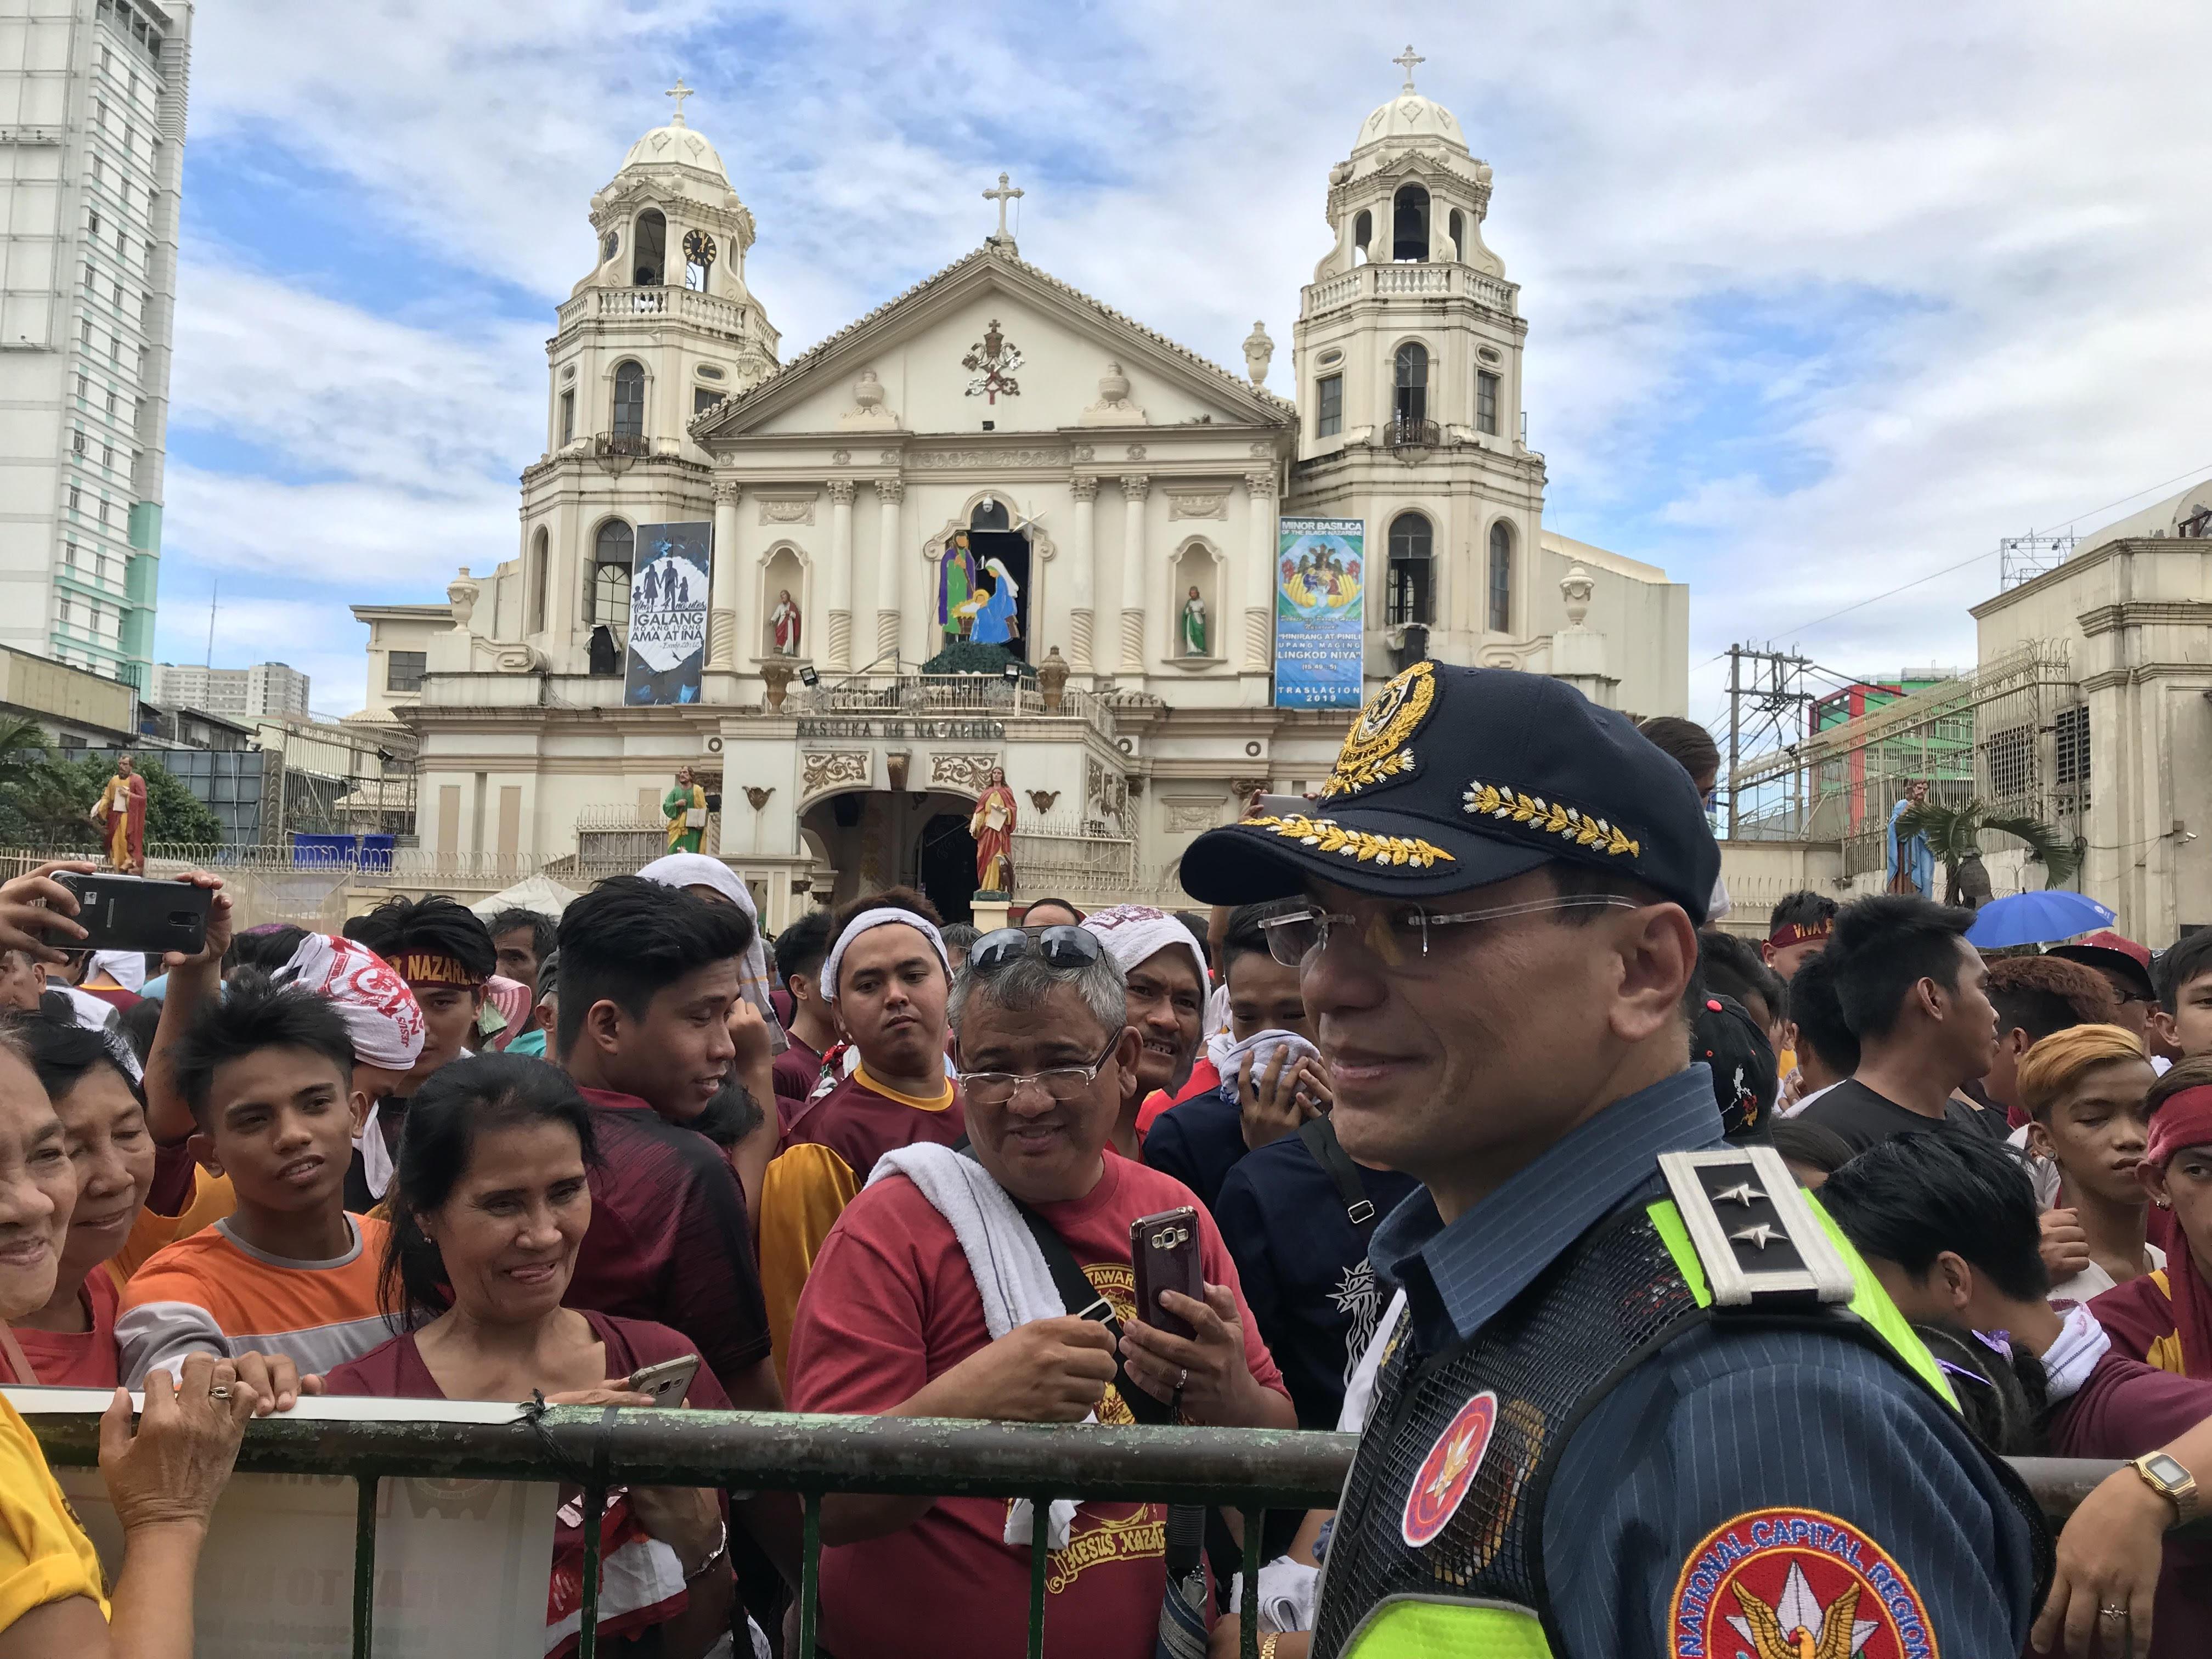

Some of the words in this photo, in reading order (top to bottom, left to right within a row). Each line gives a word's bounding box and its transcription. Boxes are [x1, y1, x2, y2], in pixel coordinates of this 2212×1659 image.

[1282, 522, 1315, 531] MINOR
[1317, 522, 1362, 531] BASILICA
[687, 600, 706, 610] utos
[634, 612, 703, 627] IGALANG
[630, 631, 660, 642] AMA
[664, 630, 679, 642] AT
[681, 630, 703, 641] INA
[883, 721, 905, 737] NG
[914, 720, 1005, 738] NAZARENO
[1793, 922, 1821, 939] VIVA
[1062, 1533, 1116, 1569] HESUS
[1679, 1532, 1752, 1658] NATIONAL
[1751, 1519, 1863, 1571] CAPITAL
[1867, 1561, 1931, 1659] REGION
